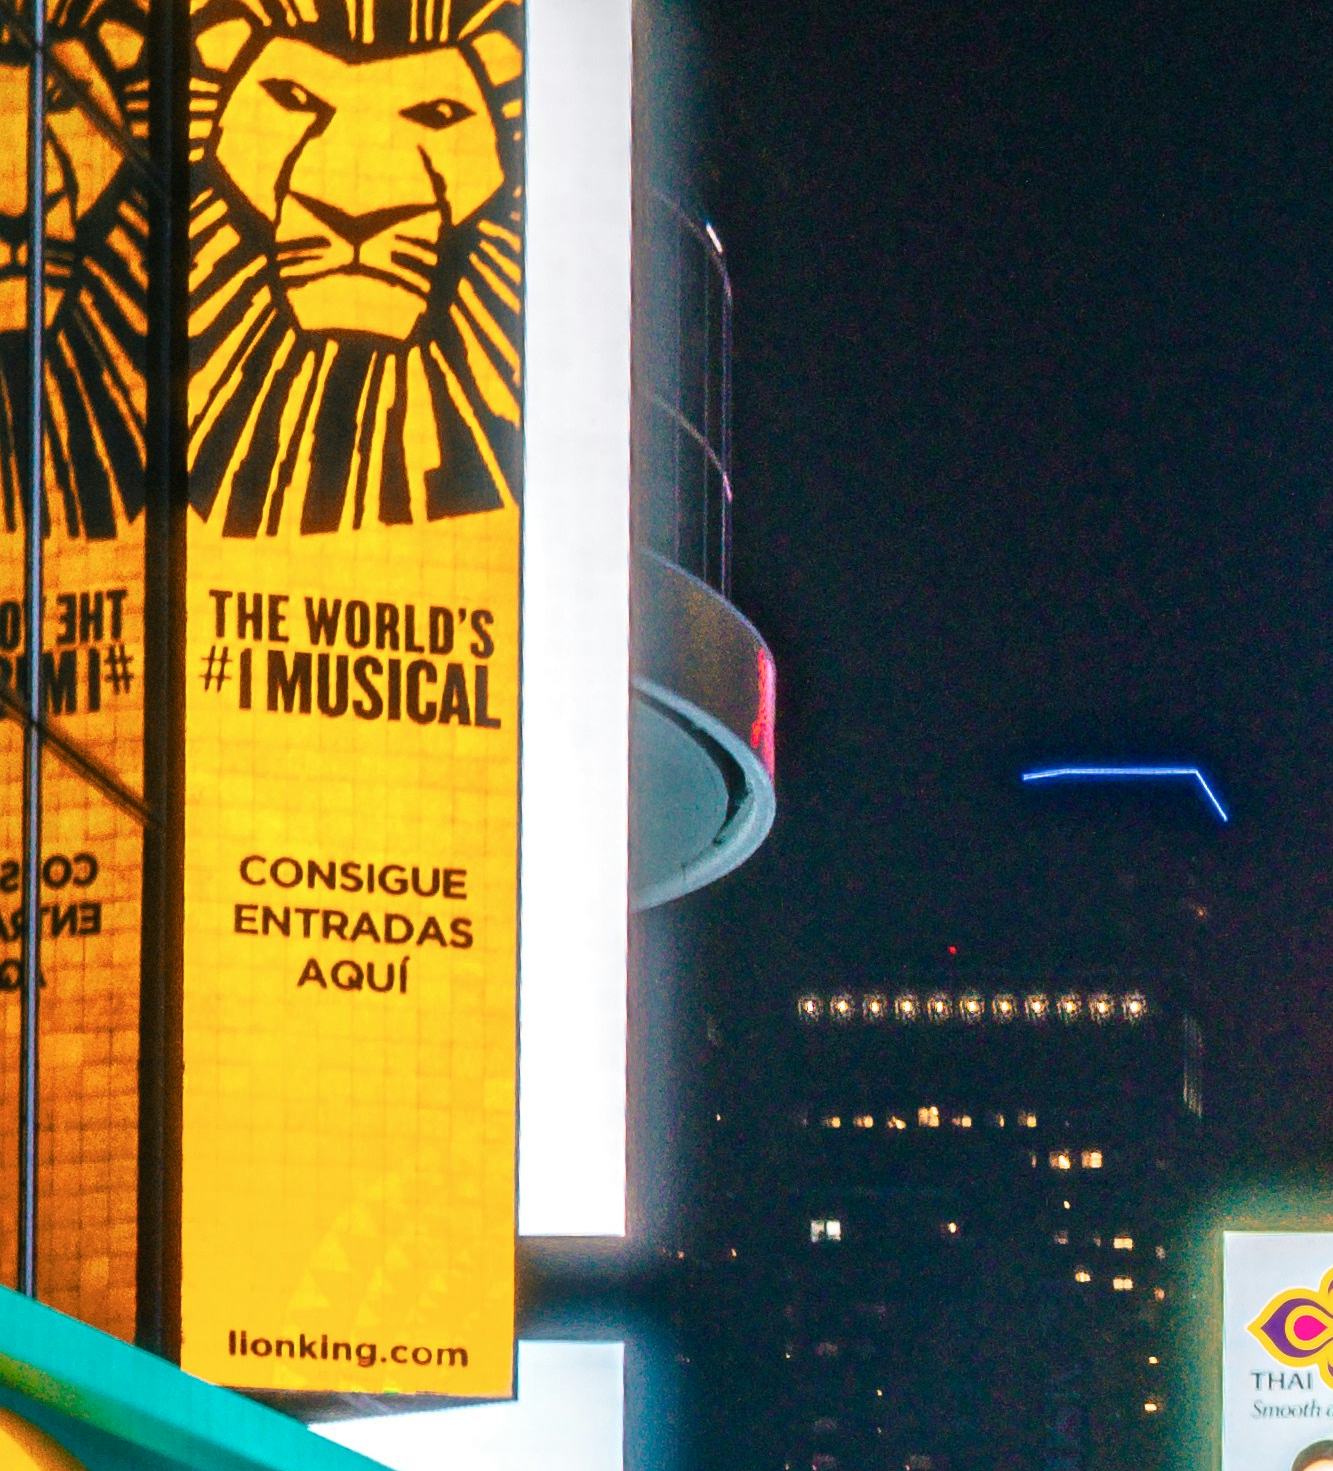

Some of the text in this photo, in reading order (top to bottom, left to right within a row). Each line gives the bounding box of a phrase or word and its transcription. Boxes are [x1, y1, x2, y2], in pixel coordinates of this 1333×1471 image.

[209, 589, 495, 659] THE WORLD'S
[199, 646, 501, 729] #1 MUSICAL
[239, 855, 468, 900] CONSIGUE
[233, 903, 474, 949] ENTRADAS
[297, 955, 411, 994] AQUÍ
[228, 1329, 470, 1369] lionking.com
[1251, 1372, 1313, 1390] THAI
[1253, 1398, 1322, 1419] Smooth
